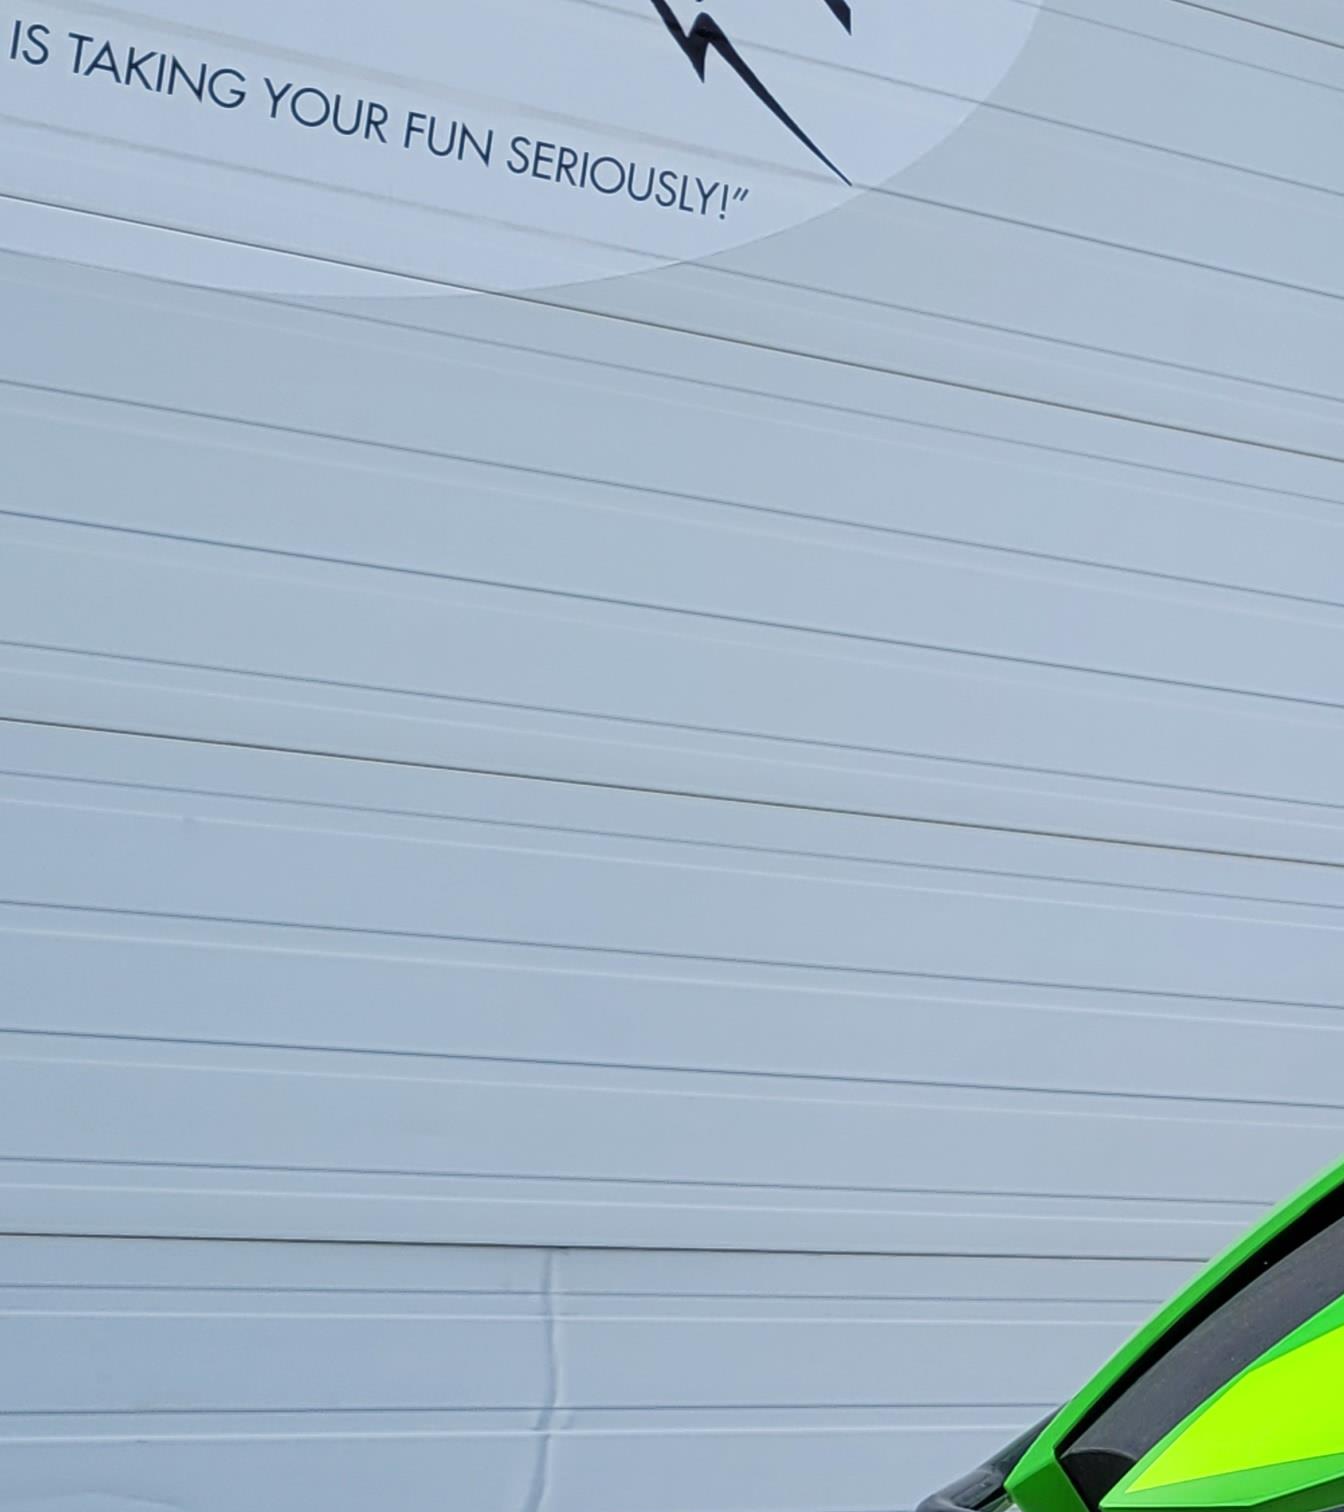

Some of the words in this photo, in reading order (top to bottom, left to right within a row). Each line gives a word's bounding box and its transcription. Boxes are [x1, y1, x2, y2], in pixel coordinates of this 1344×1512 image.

[10, 20, 50, 66] IS
[68, 32, 247, 109] TAKING
[264, 77, 388, 144] YOUR
[403, 111, 493, 167] FUN
